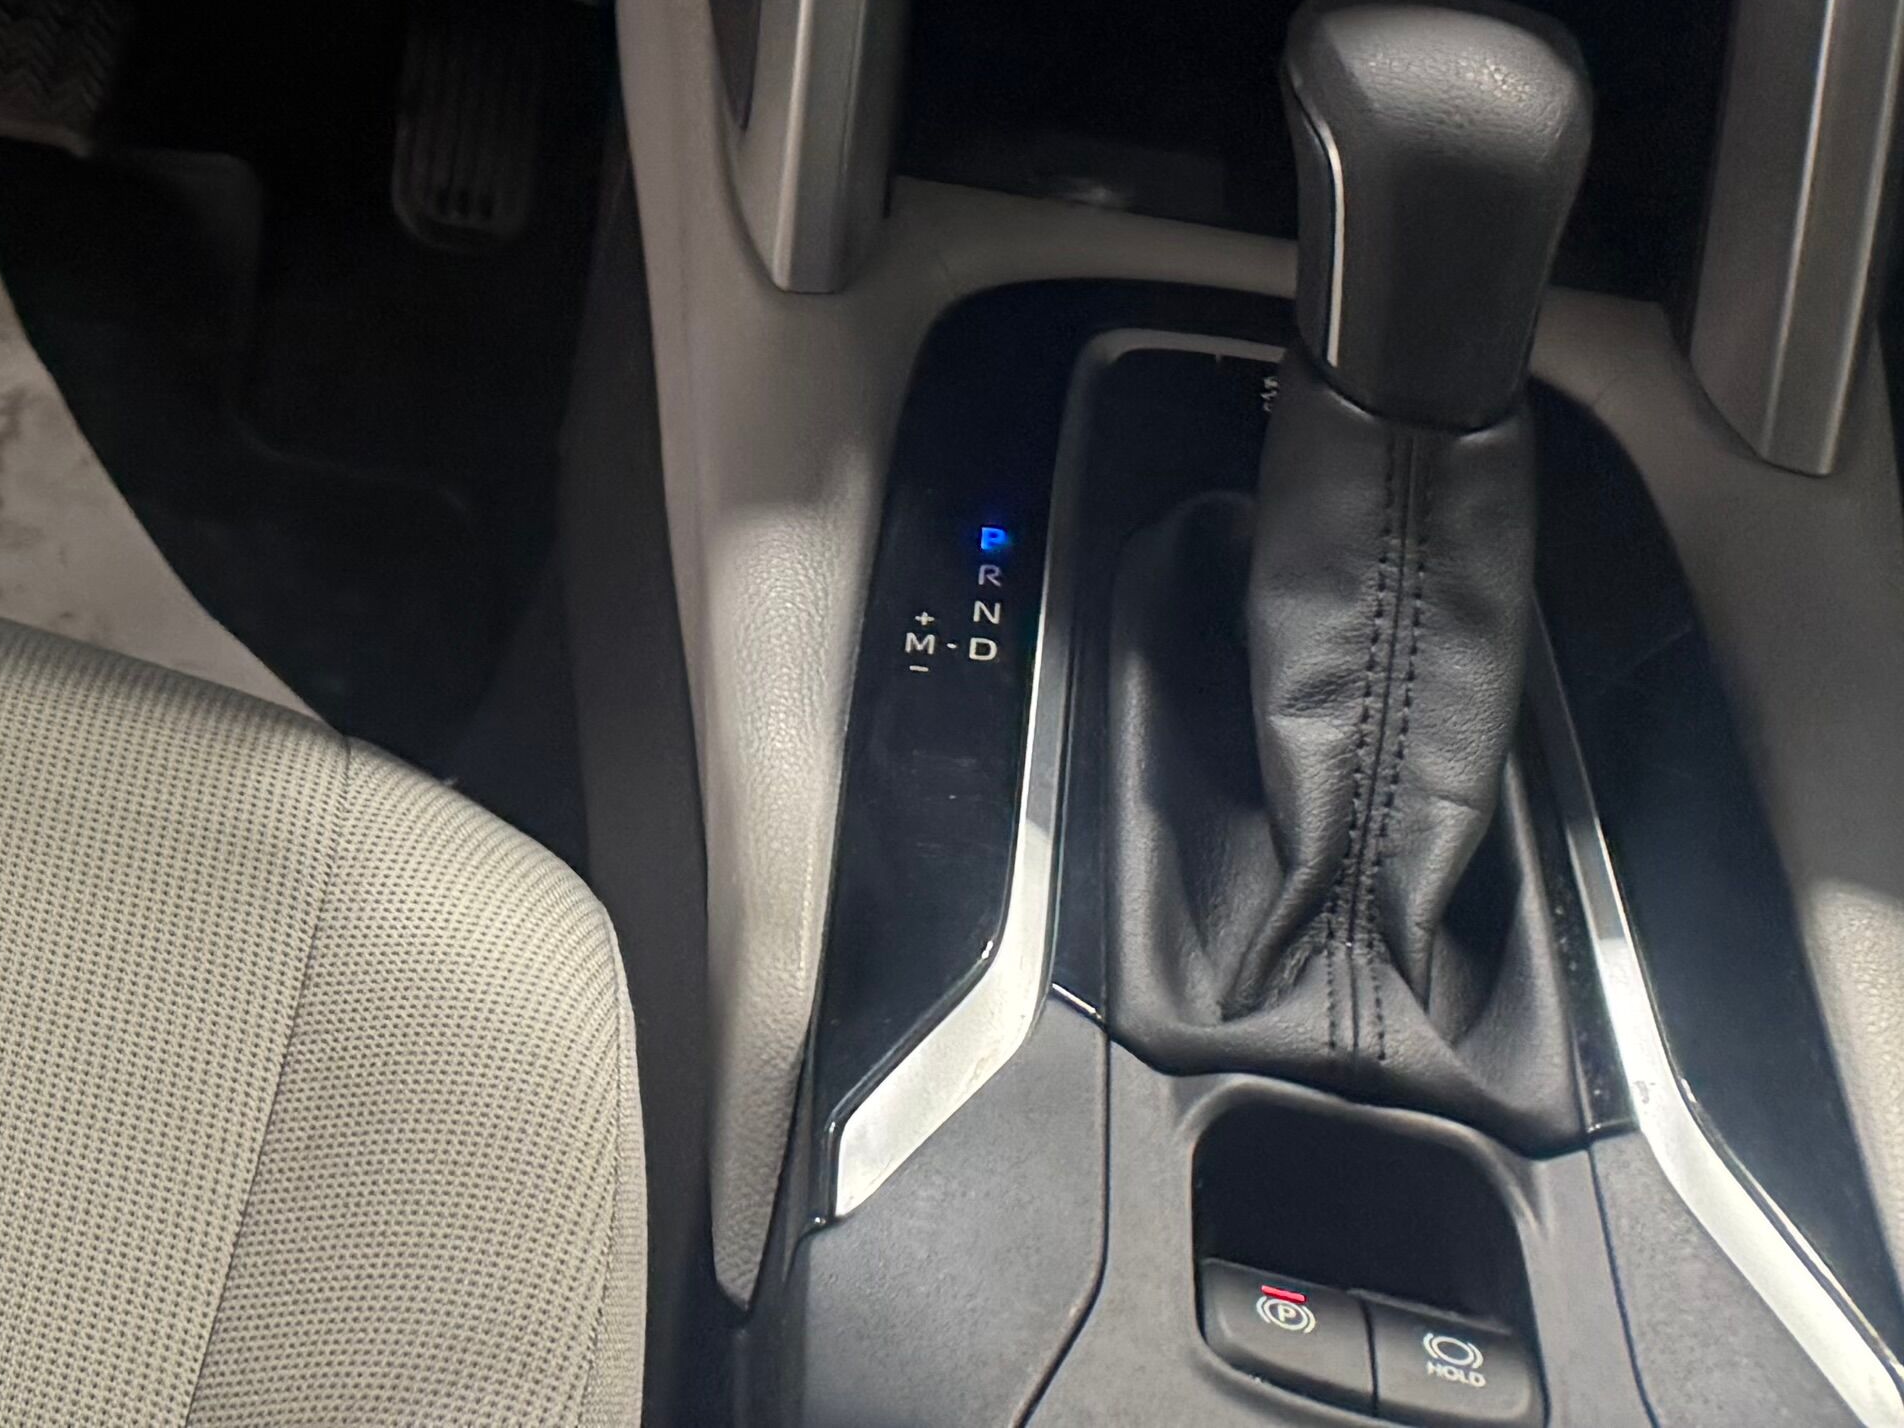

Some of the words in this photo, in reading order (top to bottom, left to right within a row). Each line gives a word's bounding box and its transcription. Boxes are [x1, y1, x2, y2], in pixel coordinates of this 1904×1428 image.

[980, 526, 1009, 550] P
[977, 564, 1003, 588] R
[973, 601, 1001, 625] N
[904, 632, 936, 655] M
[968, 637, 998, 662] D
[1427, 1360, 1487, 1388] HOLD
